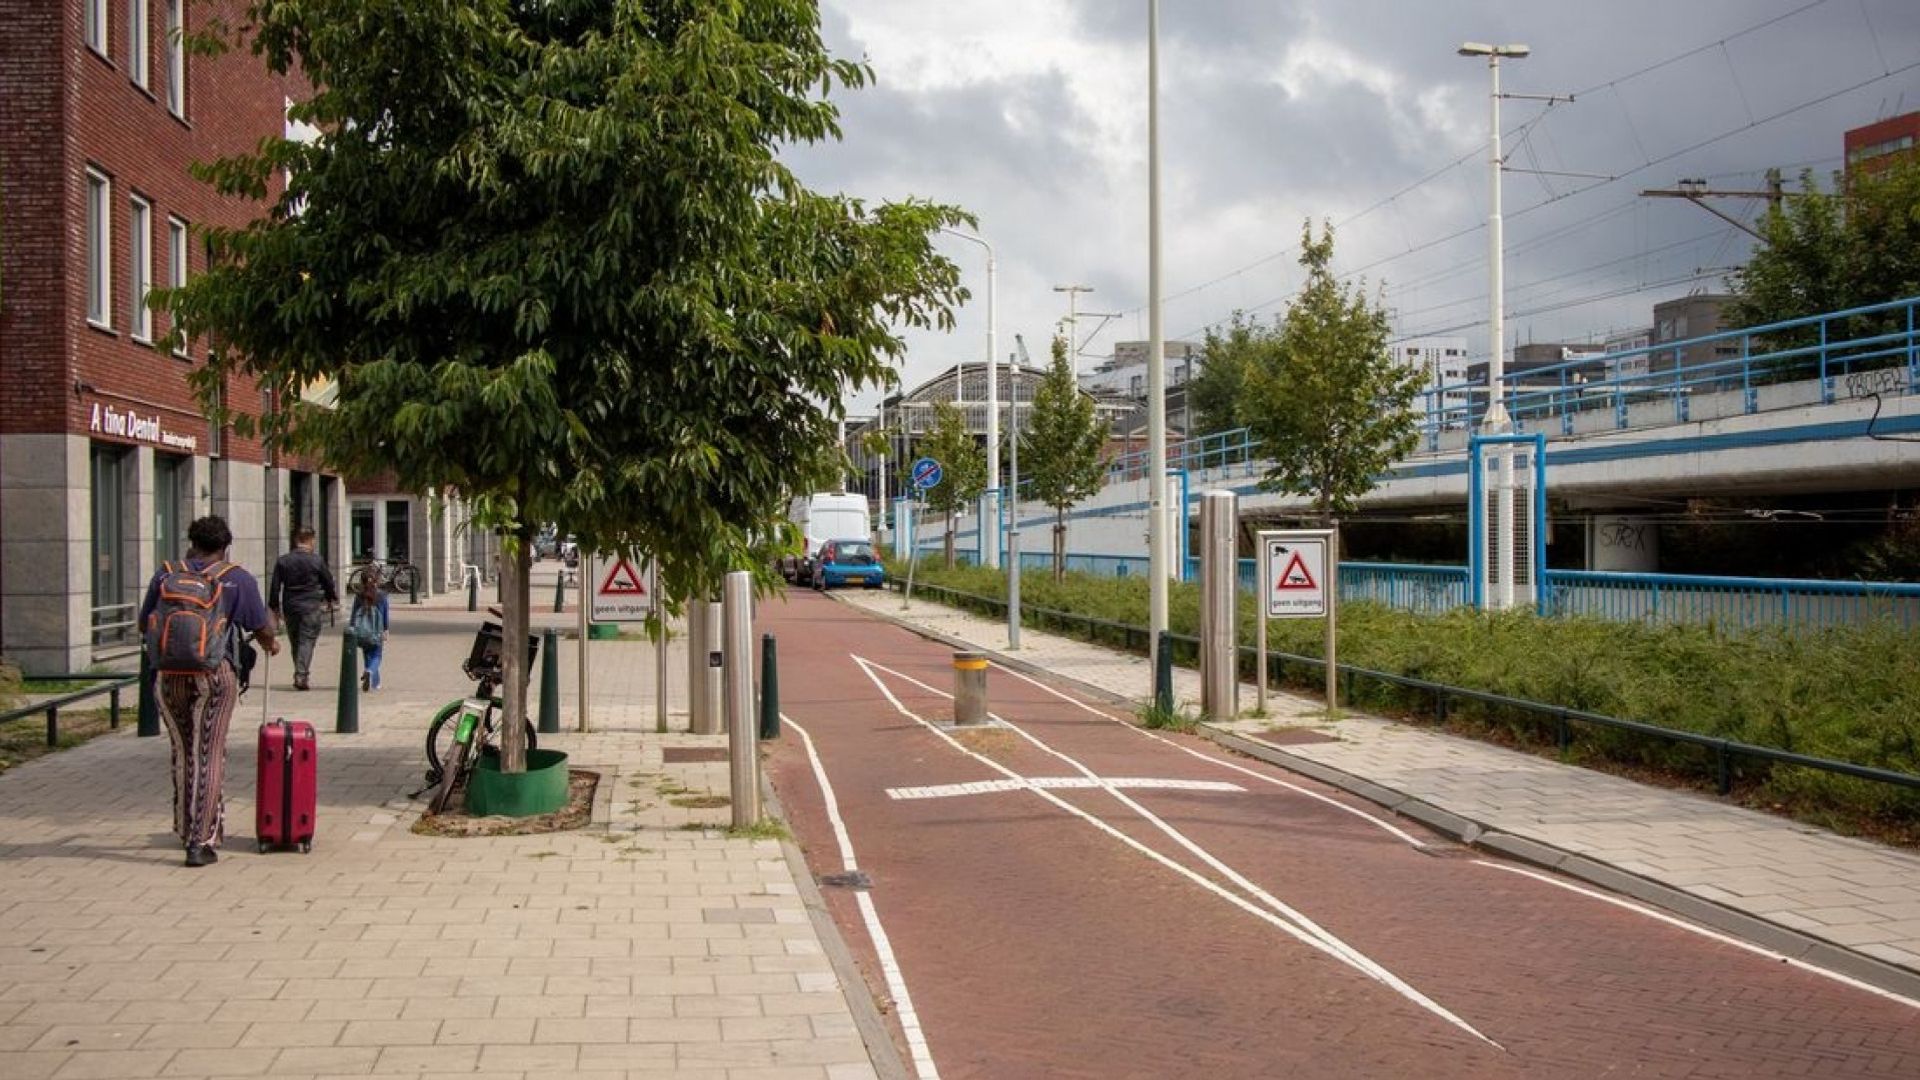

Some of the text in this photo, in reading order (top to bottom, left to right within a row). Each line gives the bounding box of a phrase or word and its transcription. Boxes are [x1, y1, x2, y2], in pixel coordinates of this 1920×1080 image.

[128, 410, 160, 442] Dental
[1274, 600, 1291, 608] geen
[595, 605, 616, 614] geen
